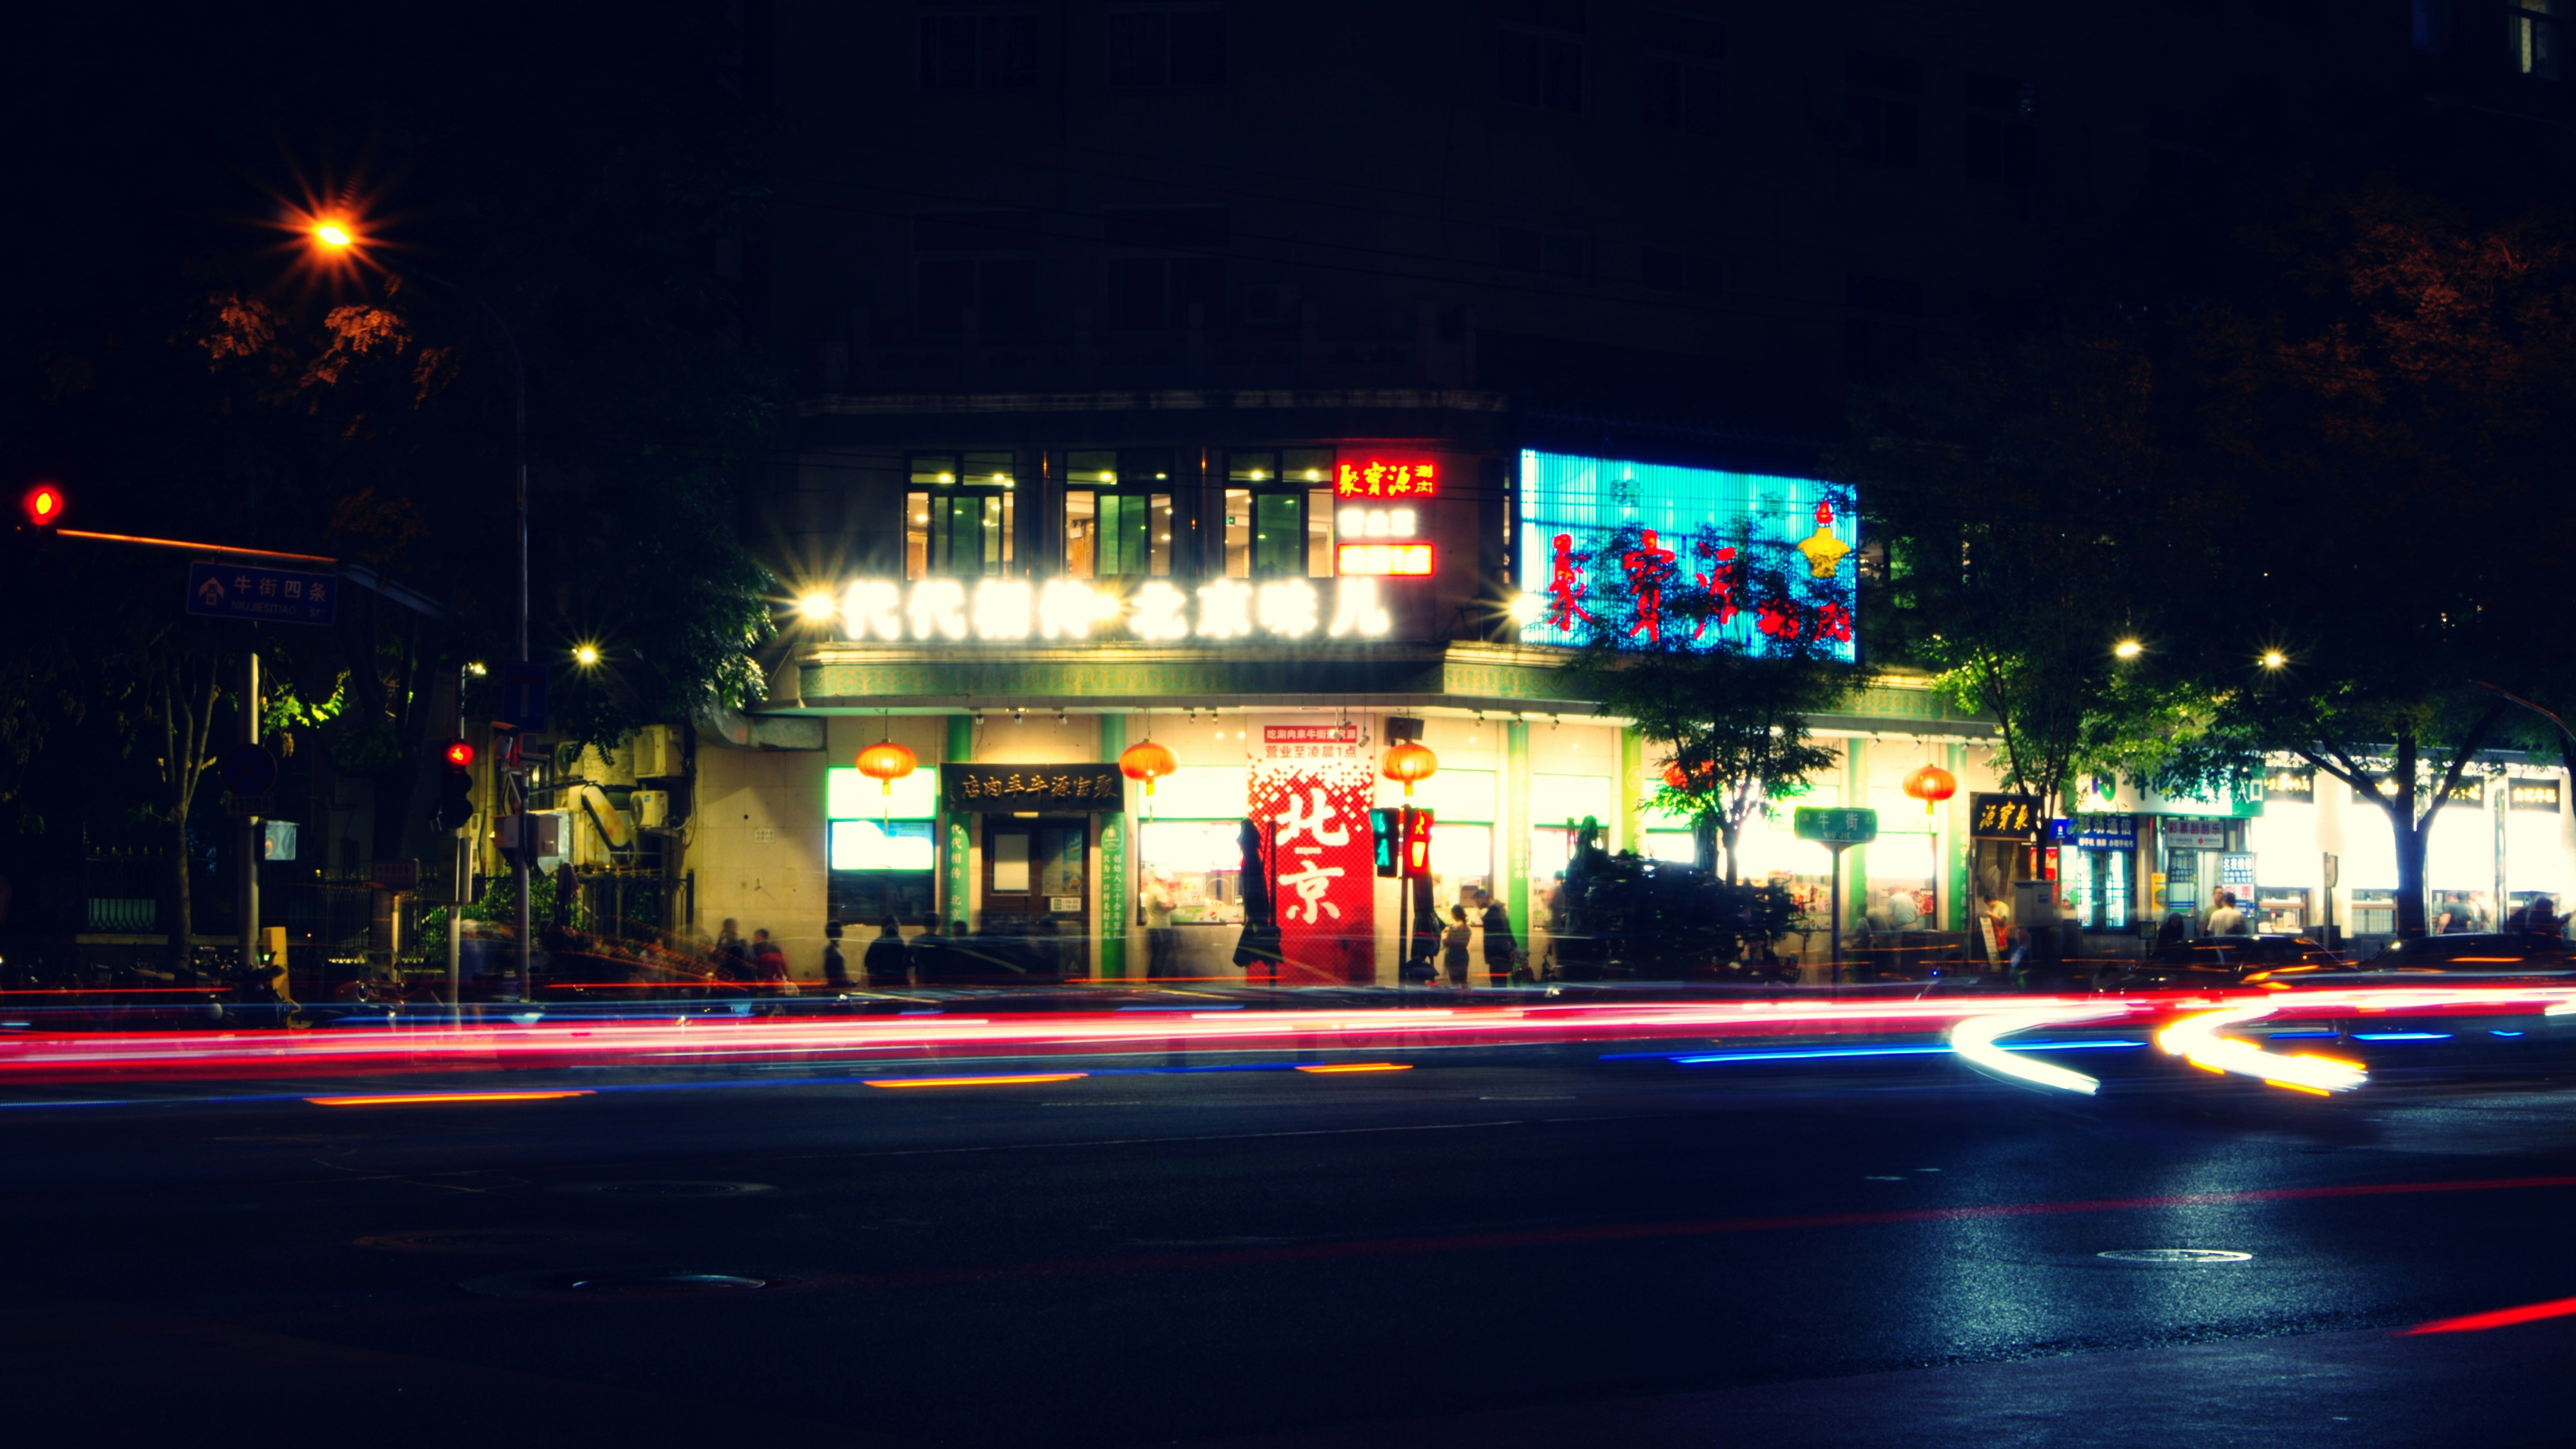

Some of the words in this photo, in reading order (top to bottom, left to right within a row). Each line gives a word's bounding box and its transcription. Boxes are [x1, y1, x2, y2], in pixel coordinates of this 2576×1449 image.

[233, 575, 327, 602] 牛街四条
[231, 600, 297, 615] NIUJIESITIAO
[1267, 729, 1356, 739] 吃涮肉来牛街宝源
[1266, 746, 1357, 758] 营业至凌晨1点
[1817, 812, 1858, 831] 牛街
[2168, 822, 2221, 835] 彩票刮刮乐
